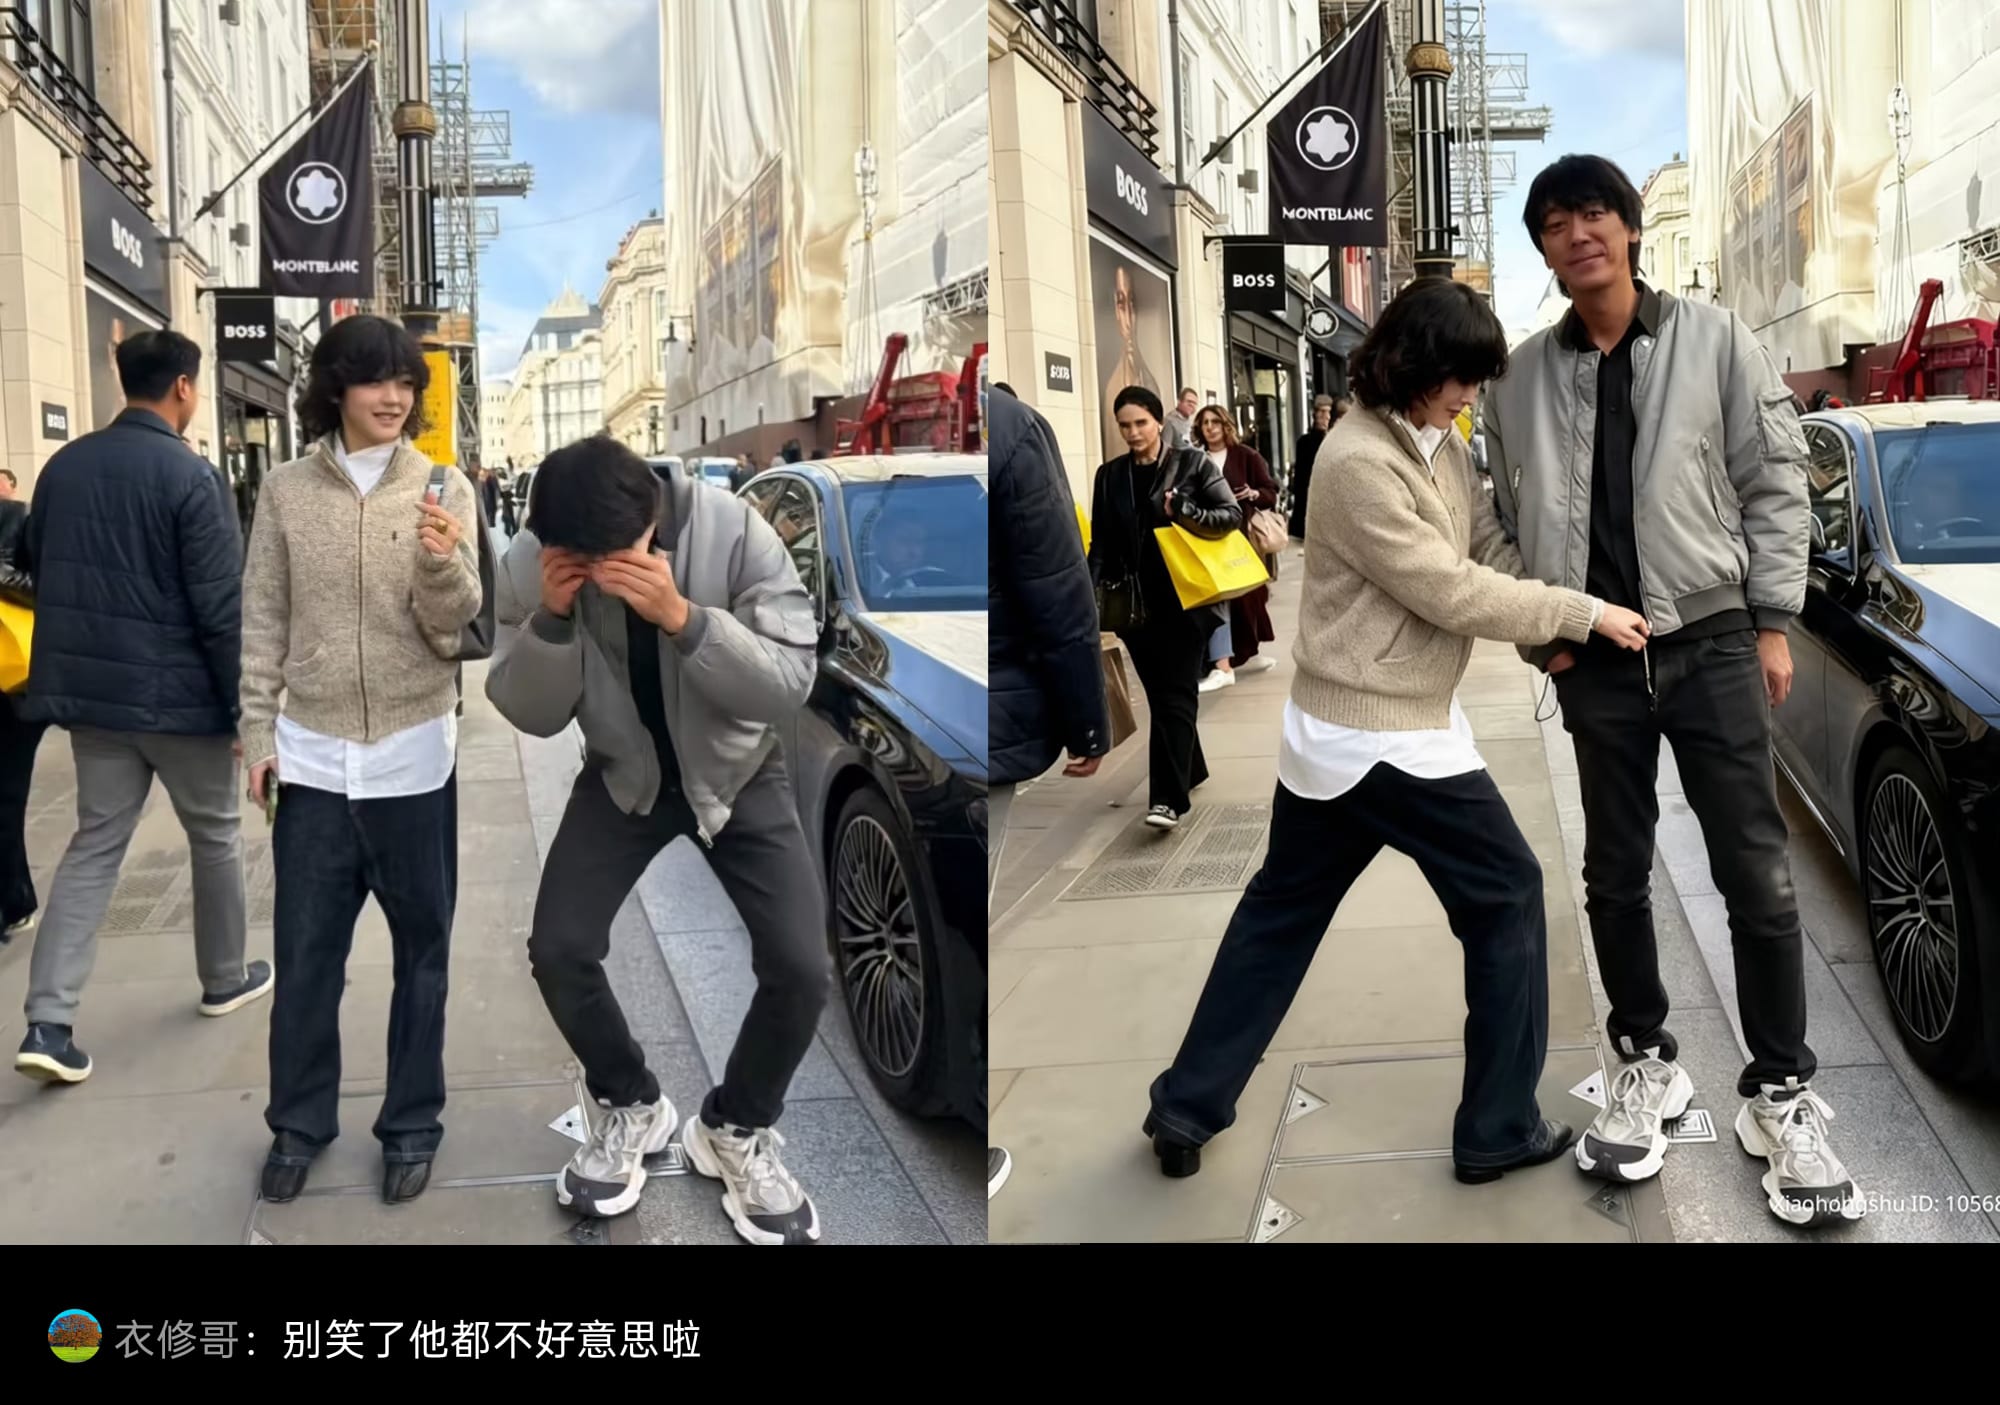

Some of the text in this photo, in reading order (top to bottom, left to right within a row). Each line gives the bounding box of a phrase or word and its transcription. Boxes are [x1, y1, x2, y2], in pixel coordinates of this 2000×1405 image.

[1115, 164, 1148, 216] BOSS
[1282, 206, 1374, 221] MONTBLANC
[111, 217, 144, 269] BOSS
[273, 259, 360, 273] MONTBLANC
[1232, 274, 1276, 288] BOSS
[224, 325, 267, 339] BOSS
